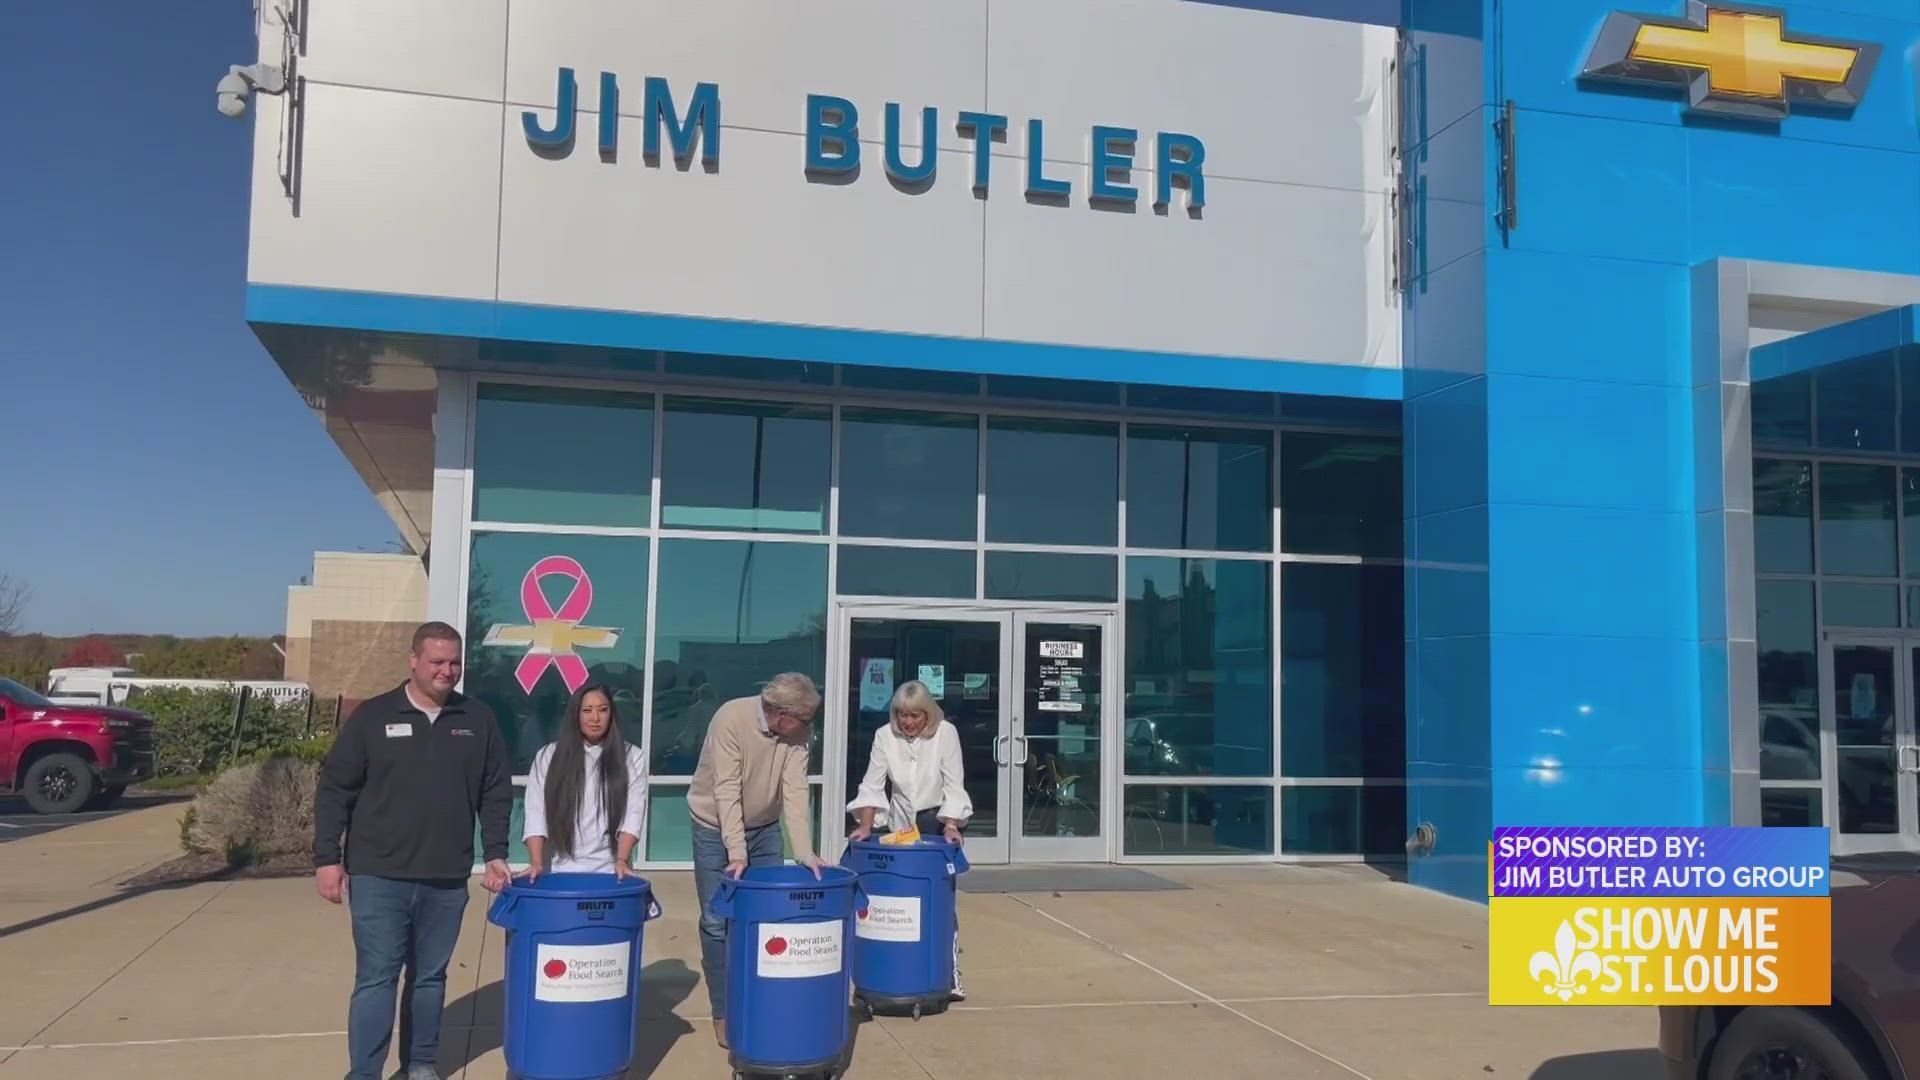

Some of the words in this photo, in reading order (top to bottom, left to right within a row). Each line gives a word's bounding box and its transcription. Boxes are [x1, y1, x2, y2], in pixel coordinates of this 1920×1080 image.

[521, 67, 719, 172] JIM
[805, 94, 1206, 218] BUTLER
[789, 891, 824, 901] BRUTE
[577, 901, 615, 910] BRUTE
[789, 935, 832, 948] Operation
[789, 947, 811, 957] Food
[813, 943, 838, 955] Search
[569, 958, 616, 970] Operation
[568, 970, 592, 981] Food
[595, 967, 624, 979] Search
